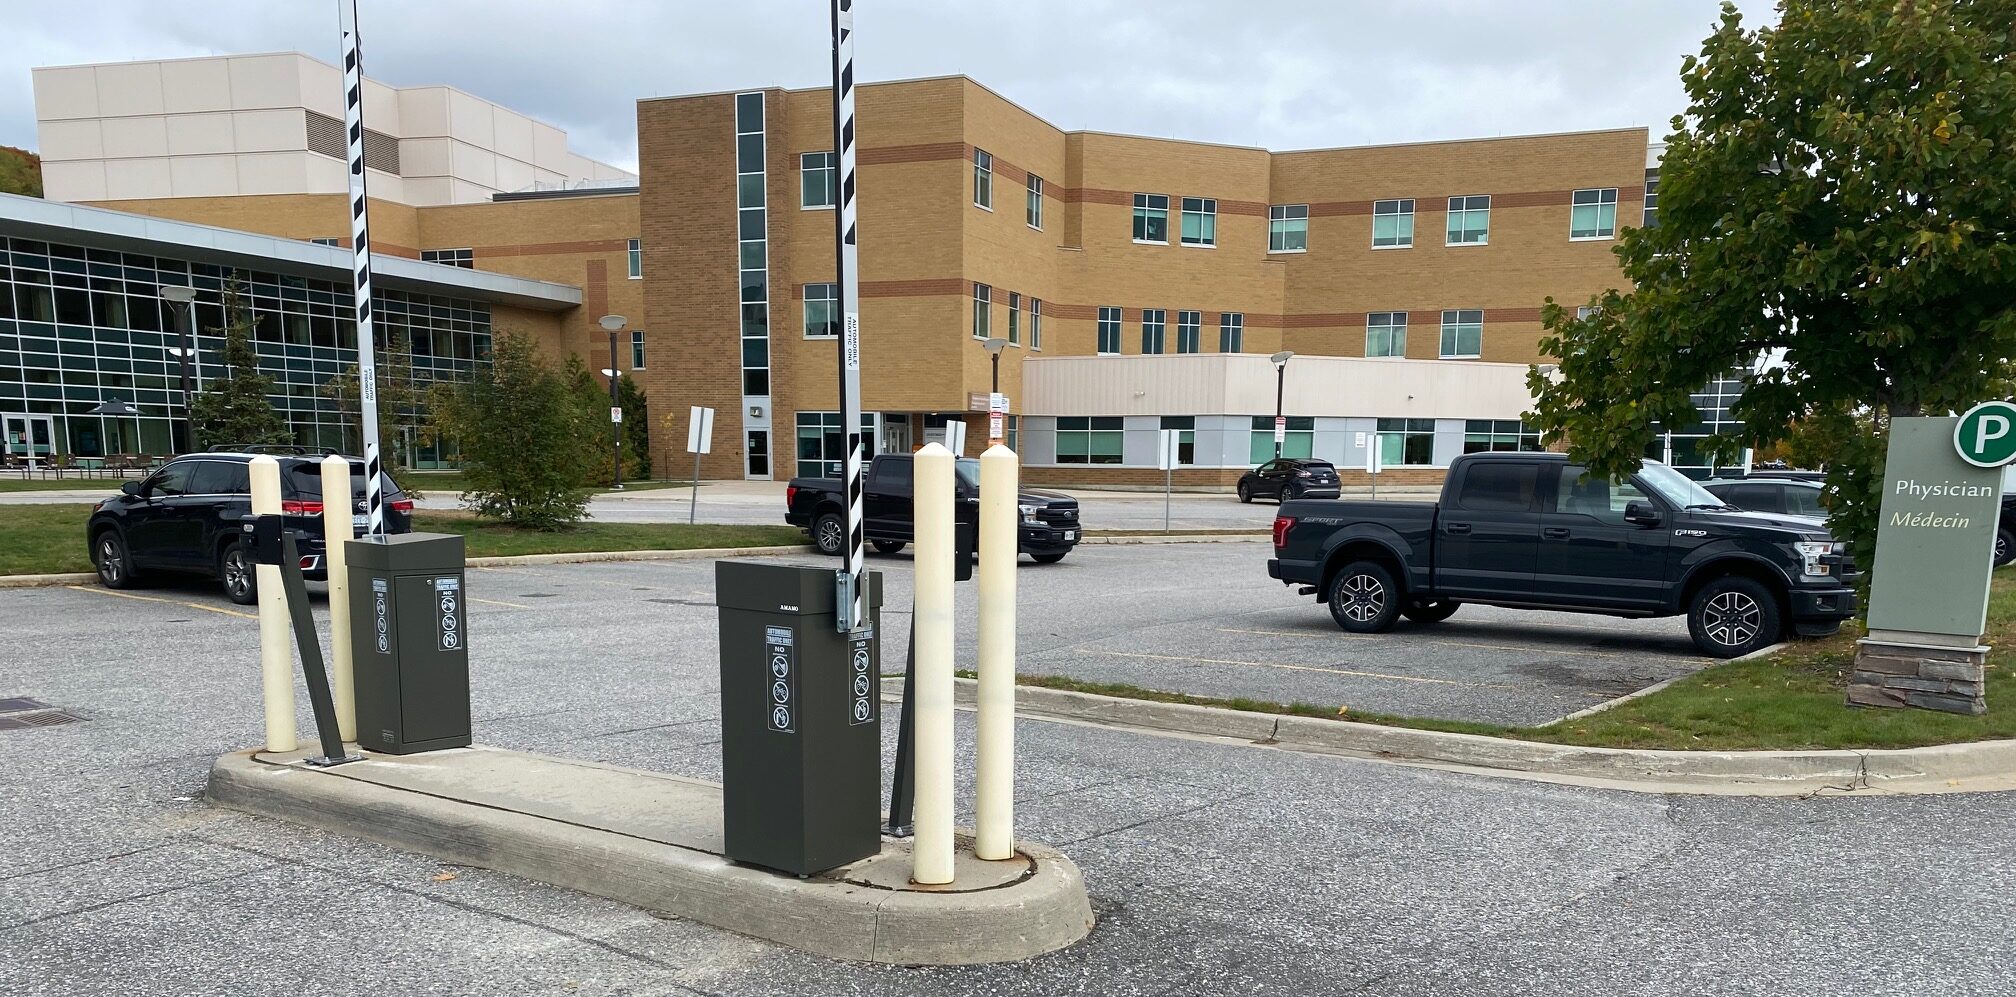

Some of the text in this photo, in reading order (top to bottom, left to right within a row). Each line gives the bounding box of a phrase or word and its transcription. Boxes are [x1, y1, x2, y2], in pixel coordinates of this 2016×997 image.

[1974, 415, 2010, 454] P
[1895, 479, 1993, 501] Physician
[1890, 511, 1970, 529] Médecin
[779, 604, 799, 612] AMANO
[774, 645, 785, 653] NO
